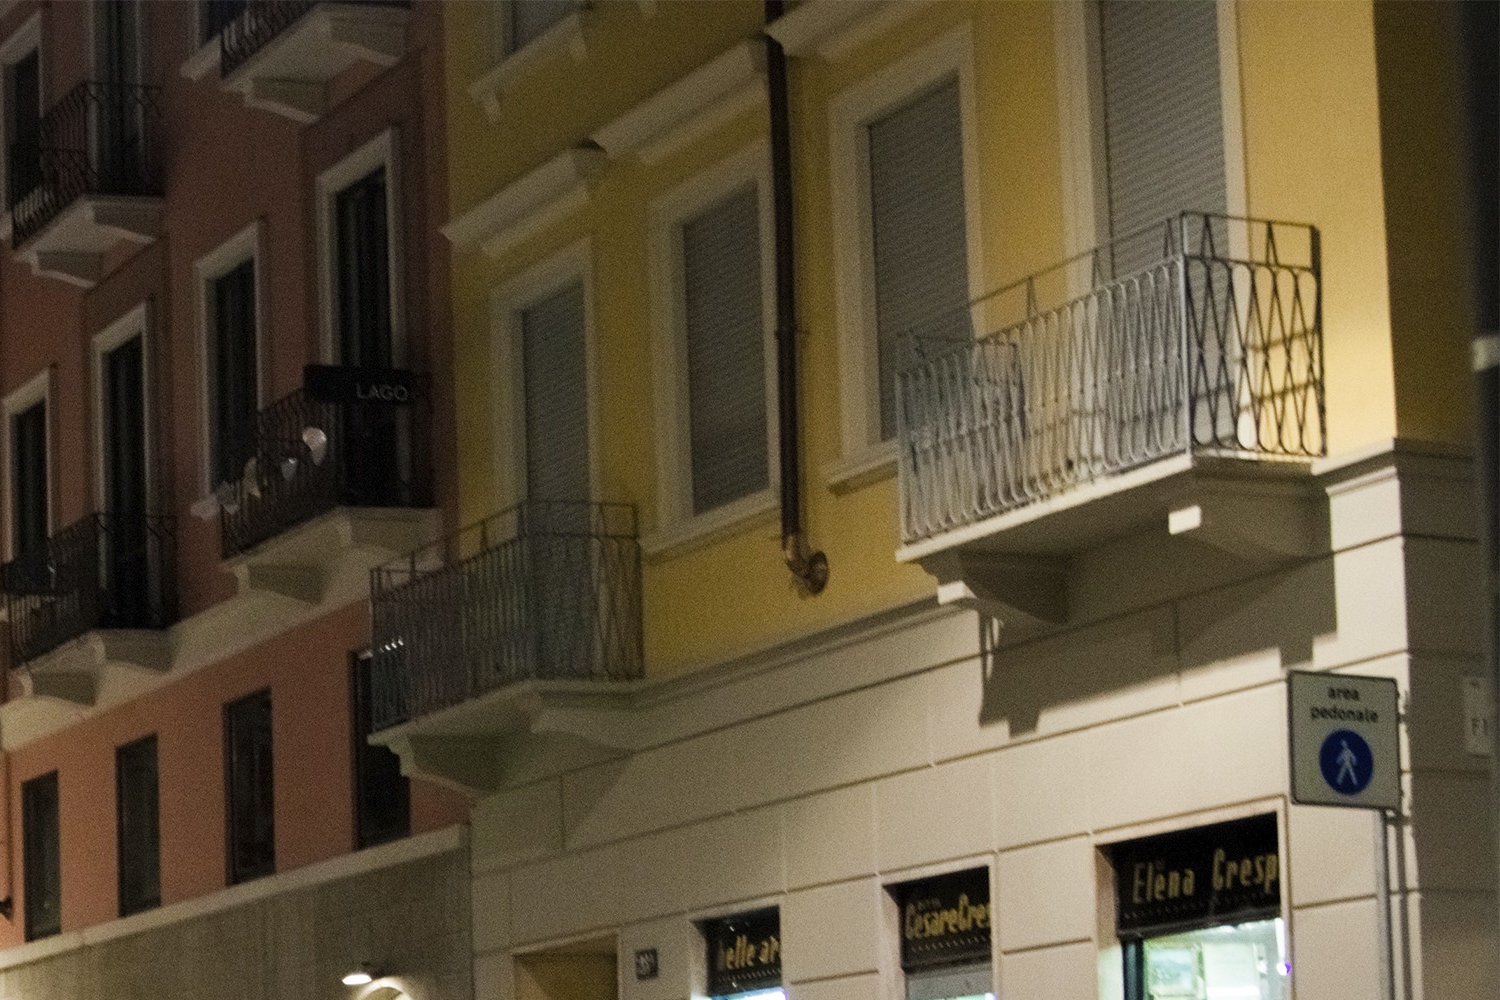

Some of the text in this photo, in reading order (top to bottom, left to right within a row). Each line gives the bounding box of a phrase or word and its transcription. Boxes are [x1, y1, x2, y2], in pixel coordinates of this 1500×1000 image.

[356, 382, 408, 402] LAGO
[1327, 687, 1360, 701] area
[1310, 705, 1379, 723] pedonale
[1132, 862, 1195, 904] Elena
